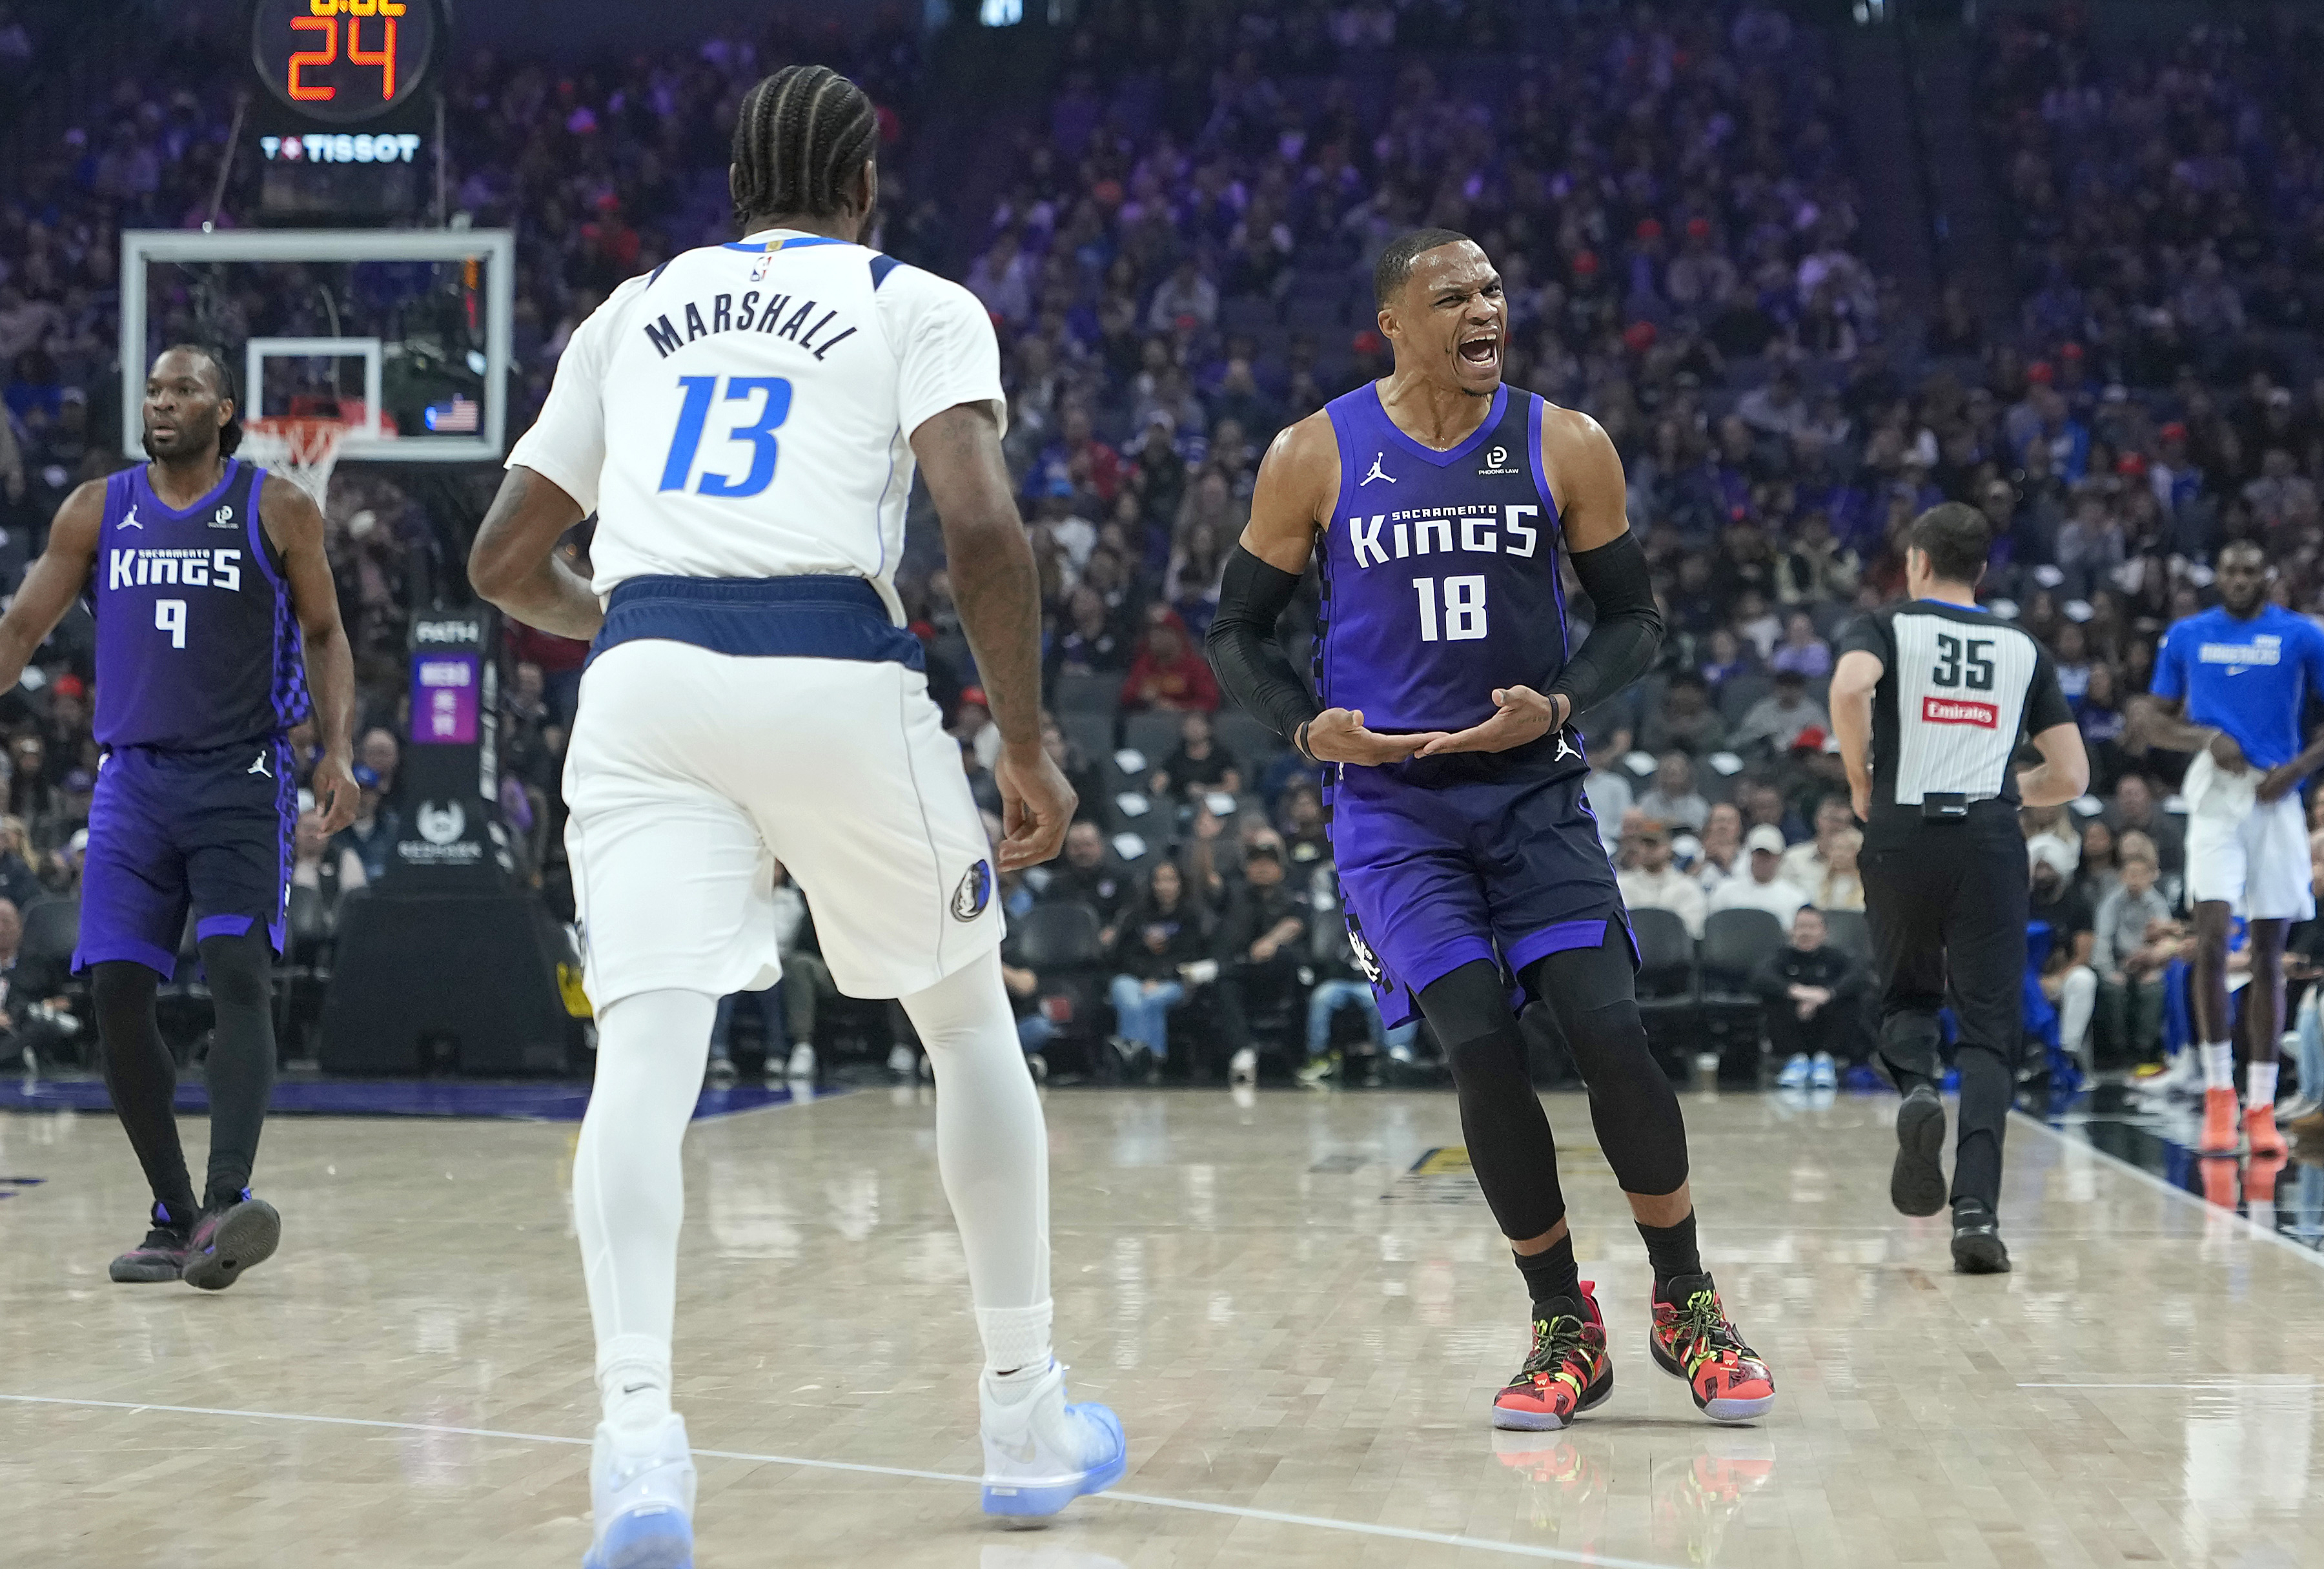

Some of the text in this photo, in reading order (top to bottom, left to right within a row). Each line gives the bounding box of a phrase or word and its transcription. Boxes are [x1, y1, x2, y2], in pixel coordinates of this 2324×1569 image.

[288, 16, 397, 101] 24
[302, 134, 420, 163] TISSOT
[644, 291, 857, 361] MARSHALL
[656, 374, 793, 499] 13
[1392, 505, 1497, 521] SACRAMENTO
[138, 549, 210, 559] SACRAMENTO
[155, 599, 187, 649] 9
[1412, 574, 1488, 642] 18
[1933, 633, 1995, 690] 35
[1928, 701, 1993, 723] Emirates
